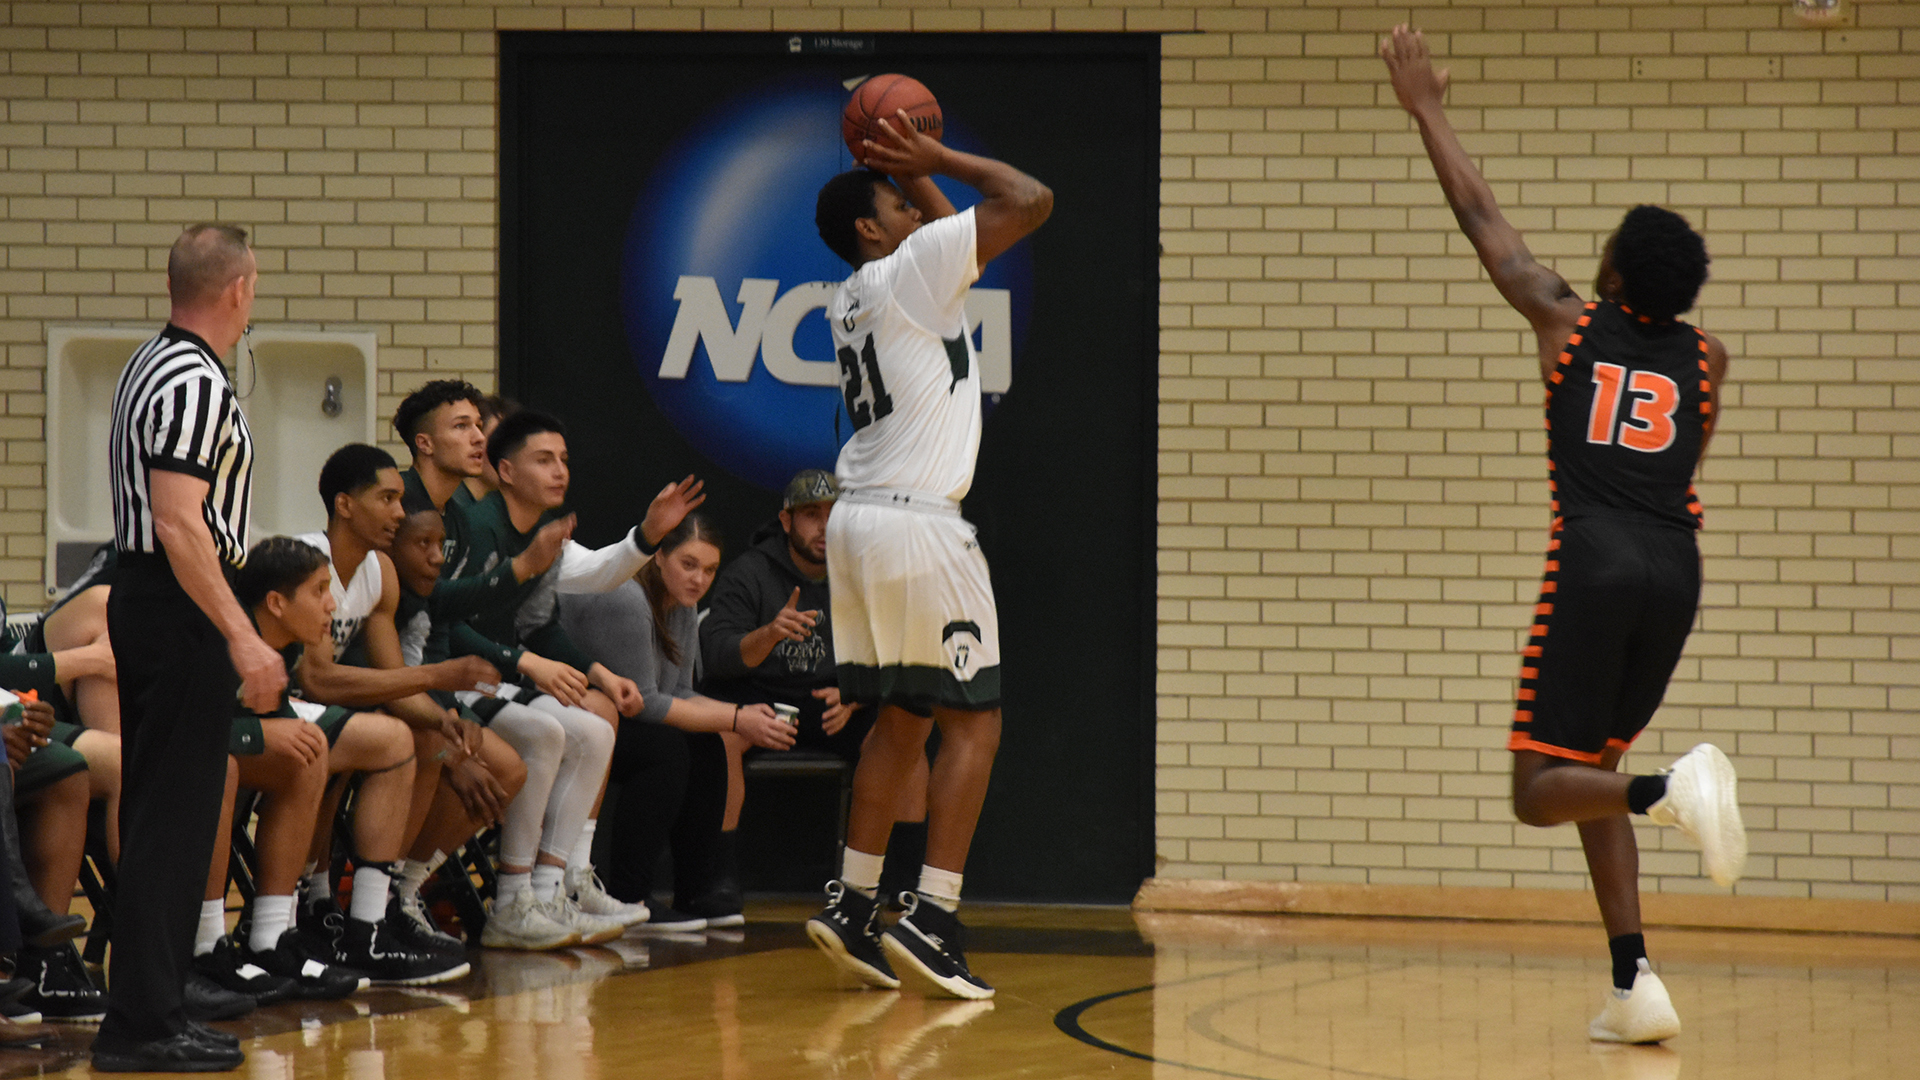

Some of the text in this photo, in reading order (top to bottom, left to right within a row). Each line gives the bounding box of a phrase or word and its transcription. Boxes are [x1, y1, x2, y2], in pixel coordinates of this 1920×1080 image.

[658, 275, 1012, 395] NCA
[837, 331, 894, 433] 21
[1586, 361, 1680, 453] 13
[812, 471, 835, 497] A
